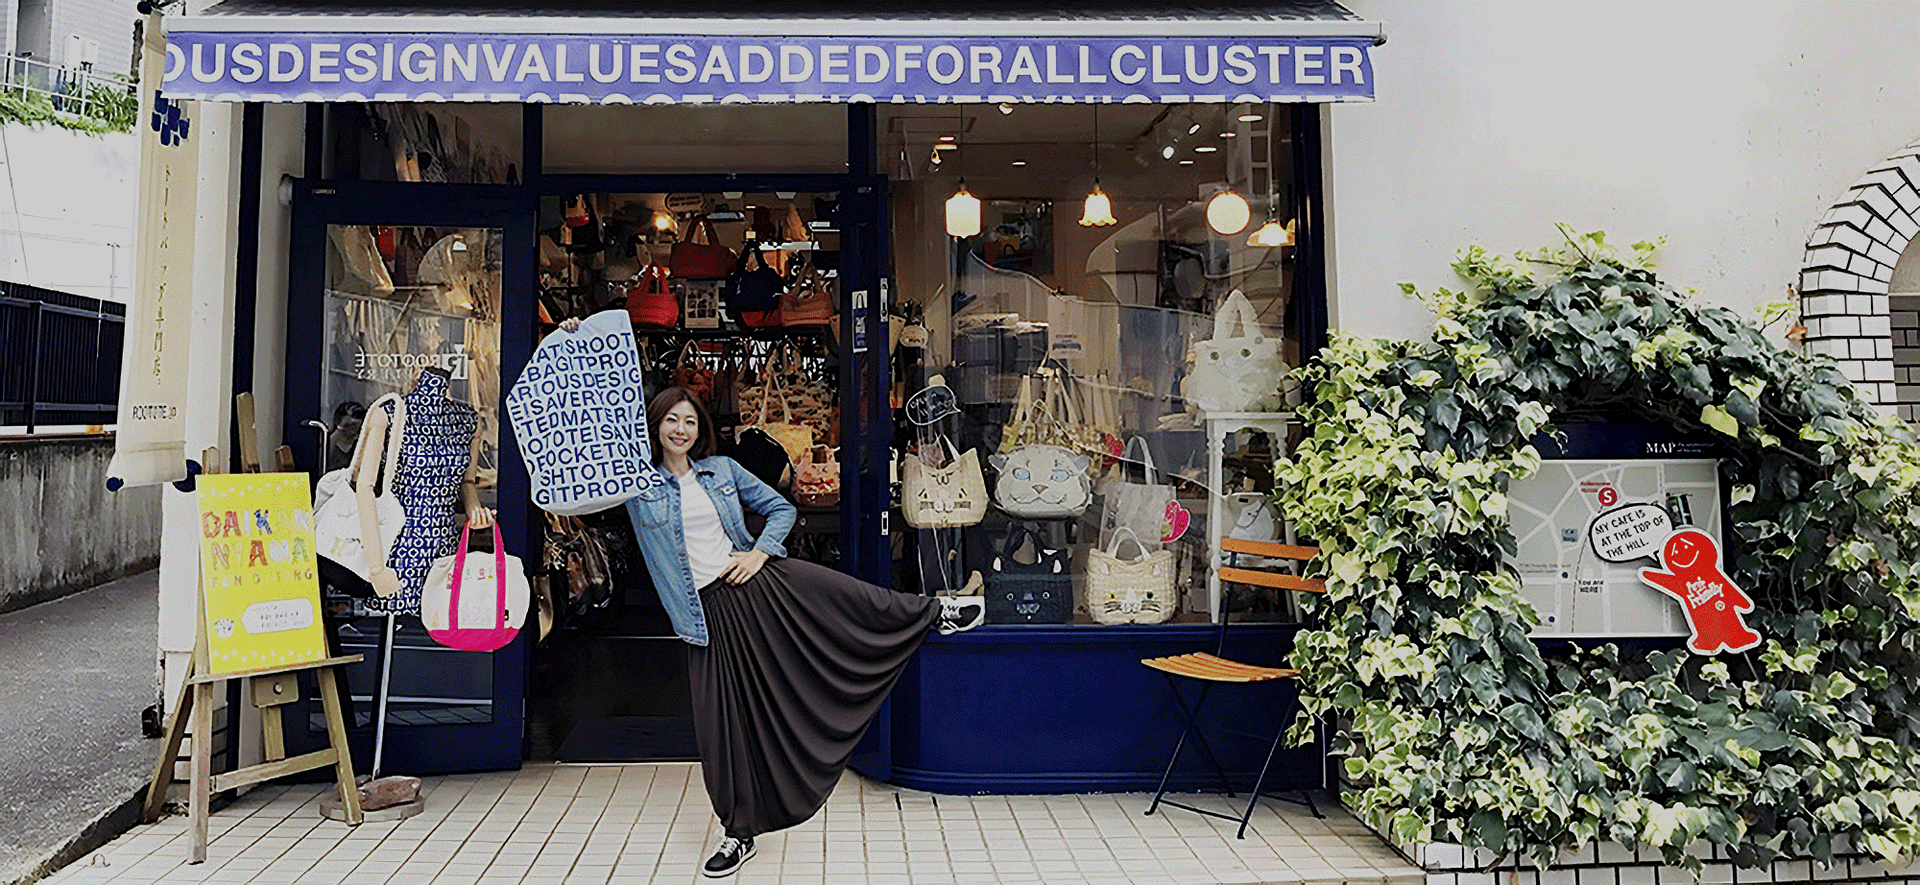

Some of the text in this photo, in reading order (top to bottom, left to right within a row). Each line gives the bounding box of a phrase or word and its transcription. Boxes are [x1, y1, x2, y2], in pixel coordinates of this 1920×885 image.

[521, 423, 647, 456] OTOTEISAVE
[1646, 442, 1676, 453] MAP
[1595, 509, 1646, 535] MY CAFE IS
[1601, 515, 1664, 546] AT THE TOP OF
[1606, 545, 1624, 558] THE
